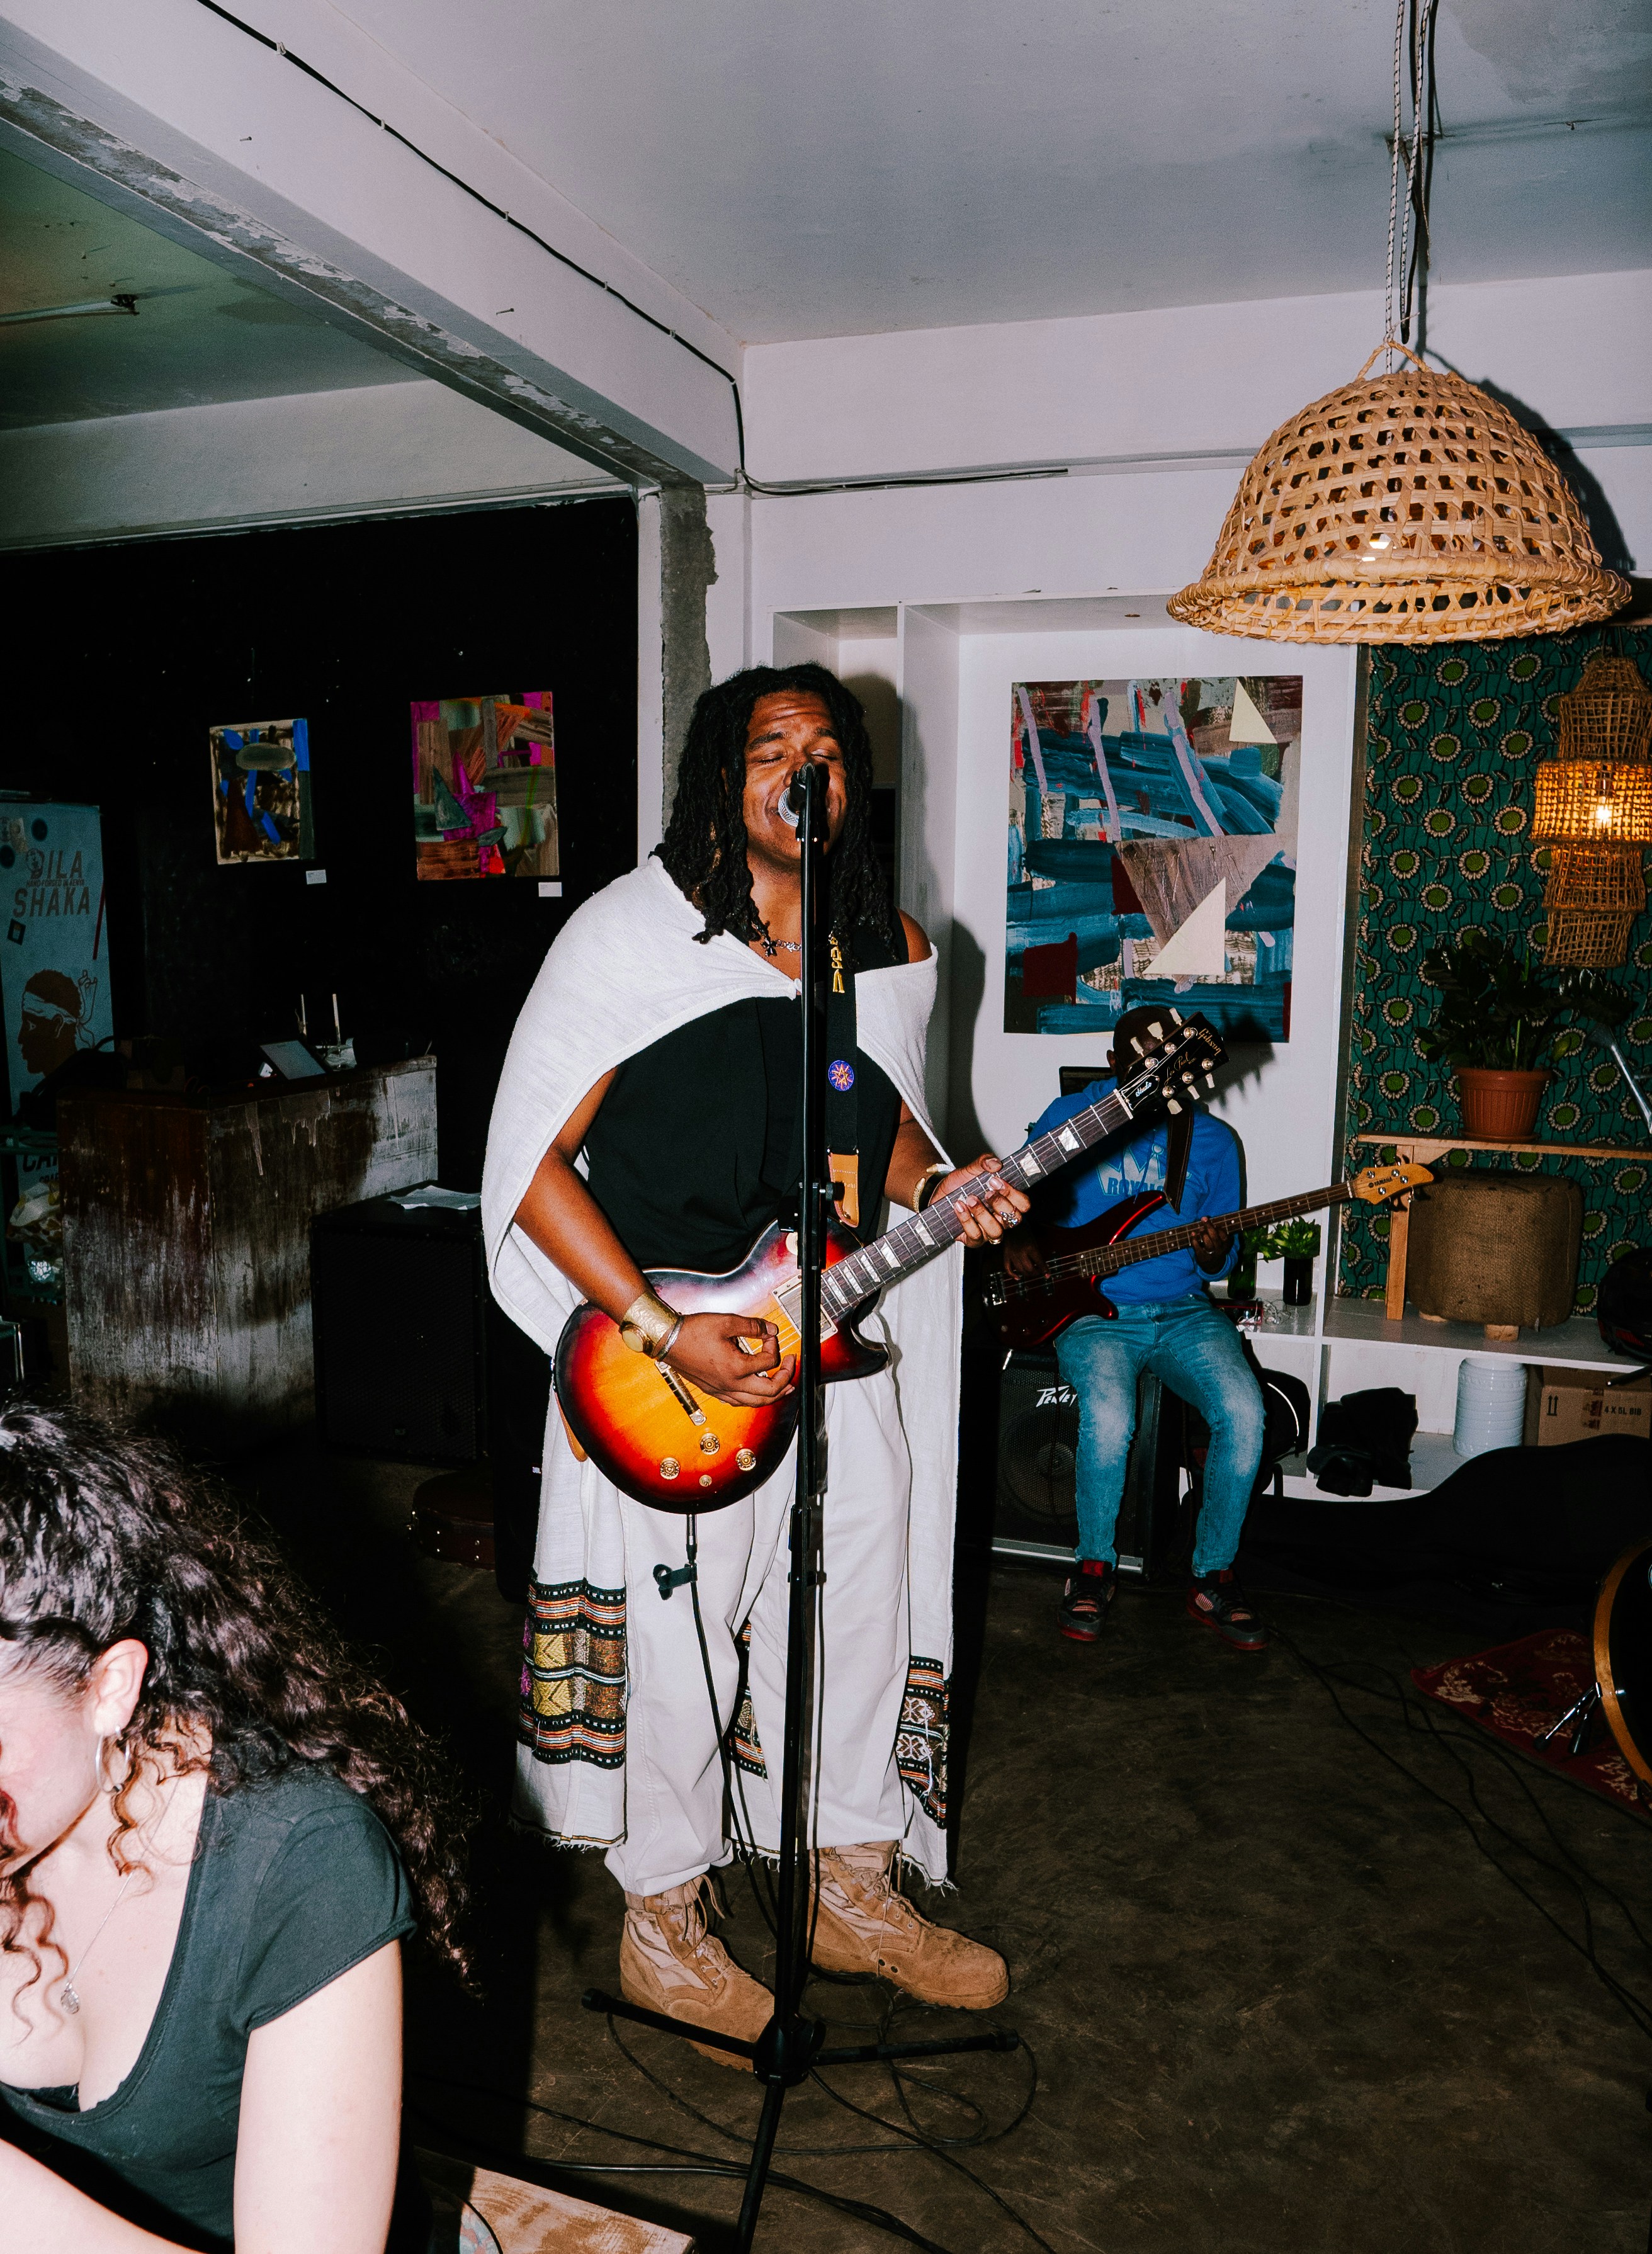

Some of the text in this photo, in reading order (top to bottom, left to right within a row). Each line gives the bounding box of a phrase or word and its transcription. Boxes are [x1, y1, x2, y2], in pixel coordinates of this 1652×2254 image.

[13, 886, 89, 918] SHAKA
[1197, 1028, 1221, 1056] Gibson
[1174, 1051, 1189, 1071] Paul
[1135, 1081, 1152, 1097] Studio
[1374, 1177, 1393, 1186] YAMAHA
[1605, 1406, 1609, 1414] 4
